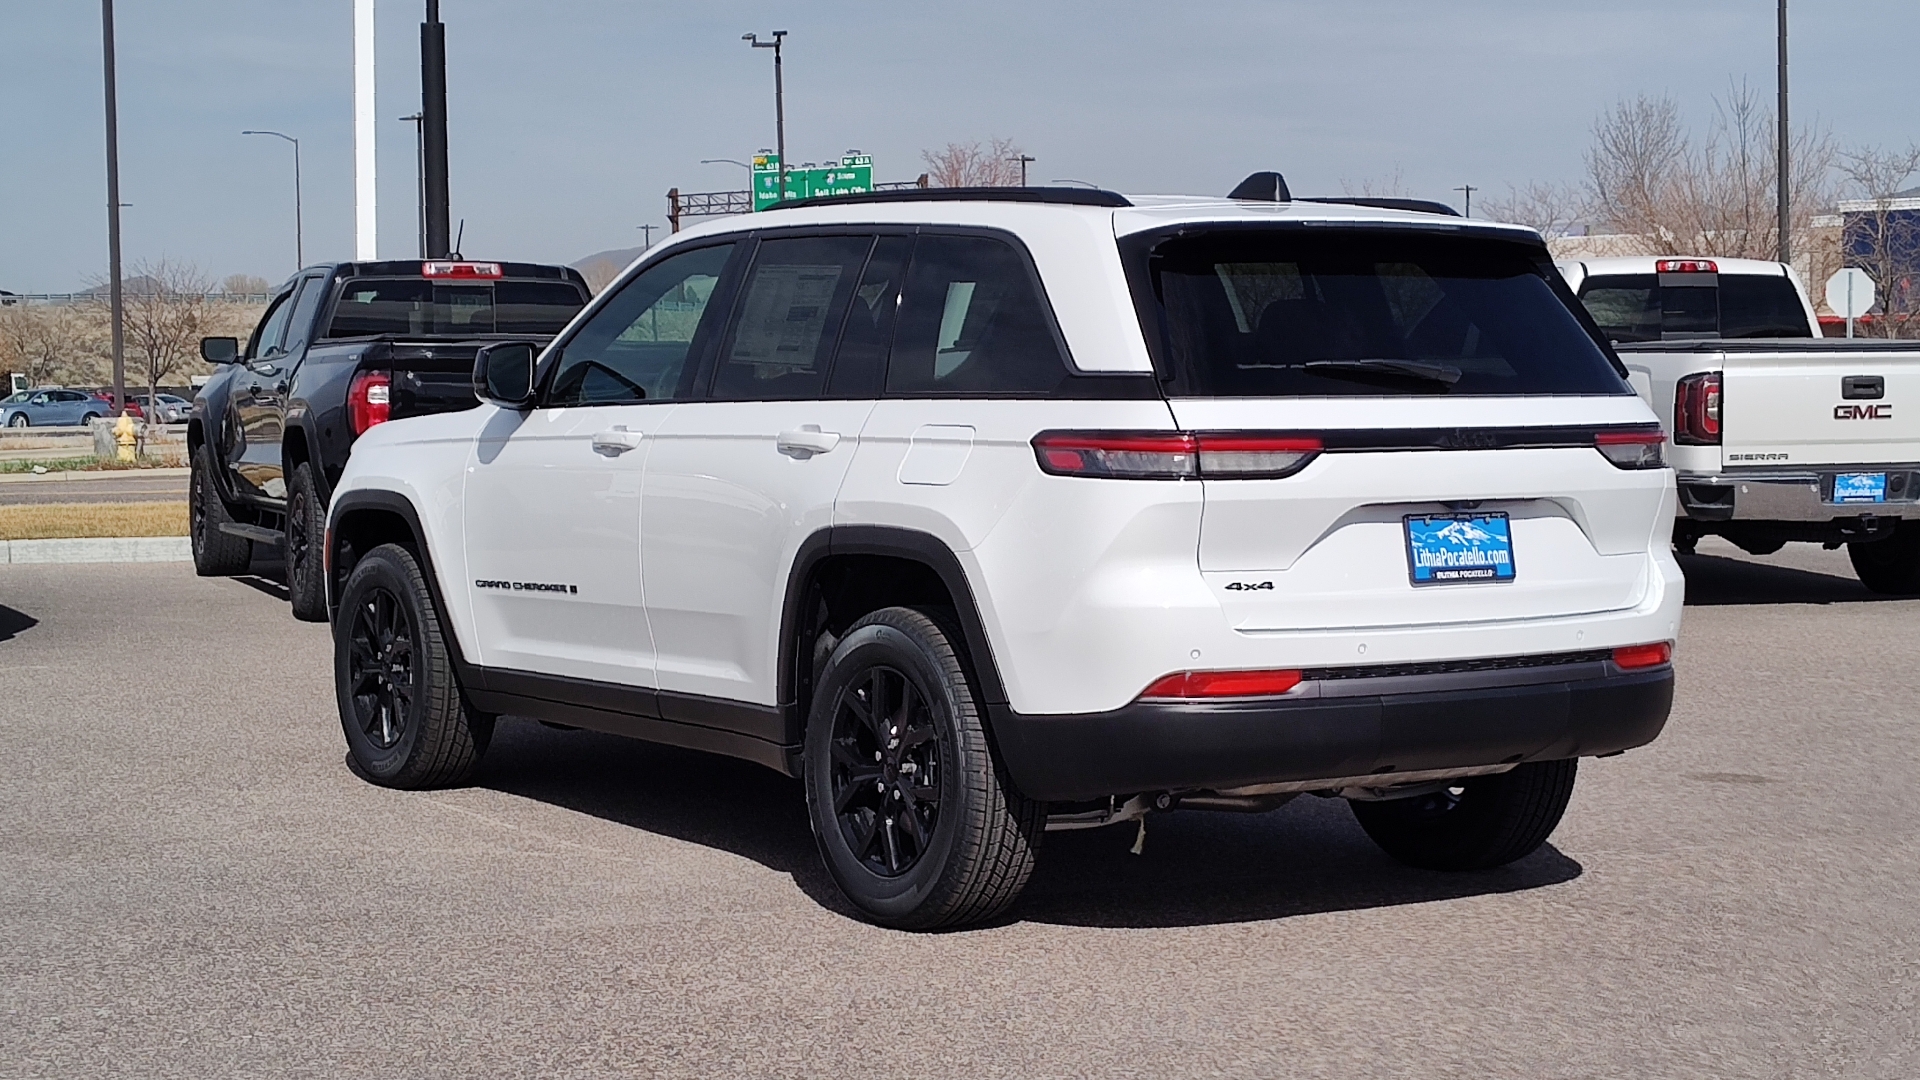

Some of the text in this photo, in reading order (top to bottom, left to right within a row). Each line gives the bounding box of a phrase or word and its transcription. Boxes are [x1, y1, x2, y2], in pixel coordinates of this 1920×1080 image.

[759, 191, 777, 199] Idaho
[815, 188, 829, 196] Salt
[831, 187, 848, 195] Lake
[1834, 405, 1892, 420] GMC
[1729, 453, 1789, 461] SIERRA
[1413, 546, 1509, 567] LithiaPocatello.com
[1460, 569, 1493, 578] POCATELLO
[475, 580, 568, 593] GRAND CHEROKEE
[1224, 581, 1275, 591] 4x4
